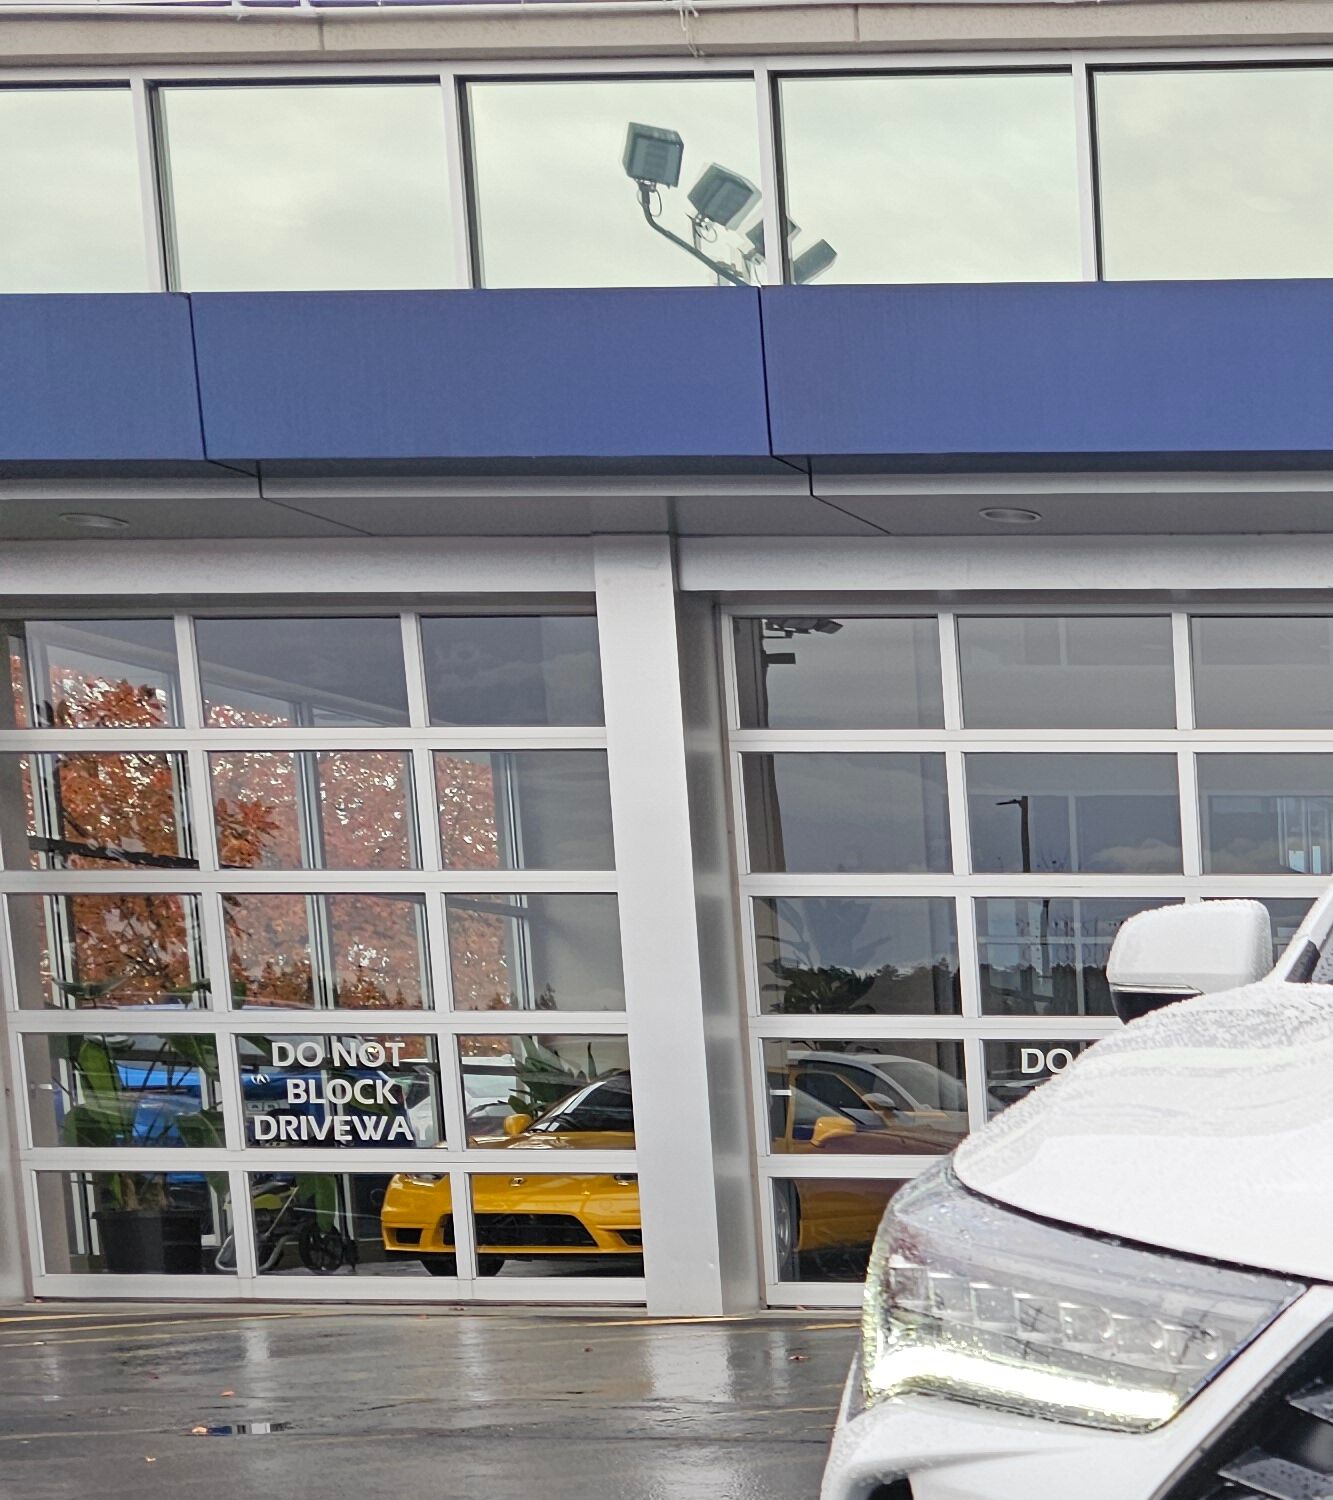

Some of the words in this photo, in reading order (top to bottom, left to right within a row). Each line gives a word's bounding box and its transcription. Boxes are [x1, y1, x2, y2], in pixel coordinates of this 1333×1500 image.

[271, 1041, 325, 1068] DO
[332, 1041, 406, 1068] NOT
[1020, 1048, 1074, 1074] DO
[286, 1078, 399, 1105] BLOCK
